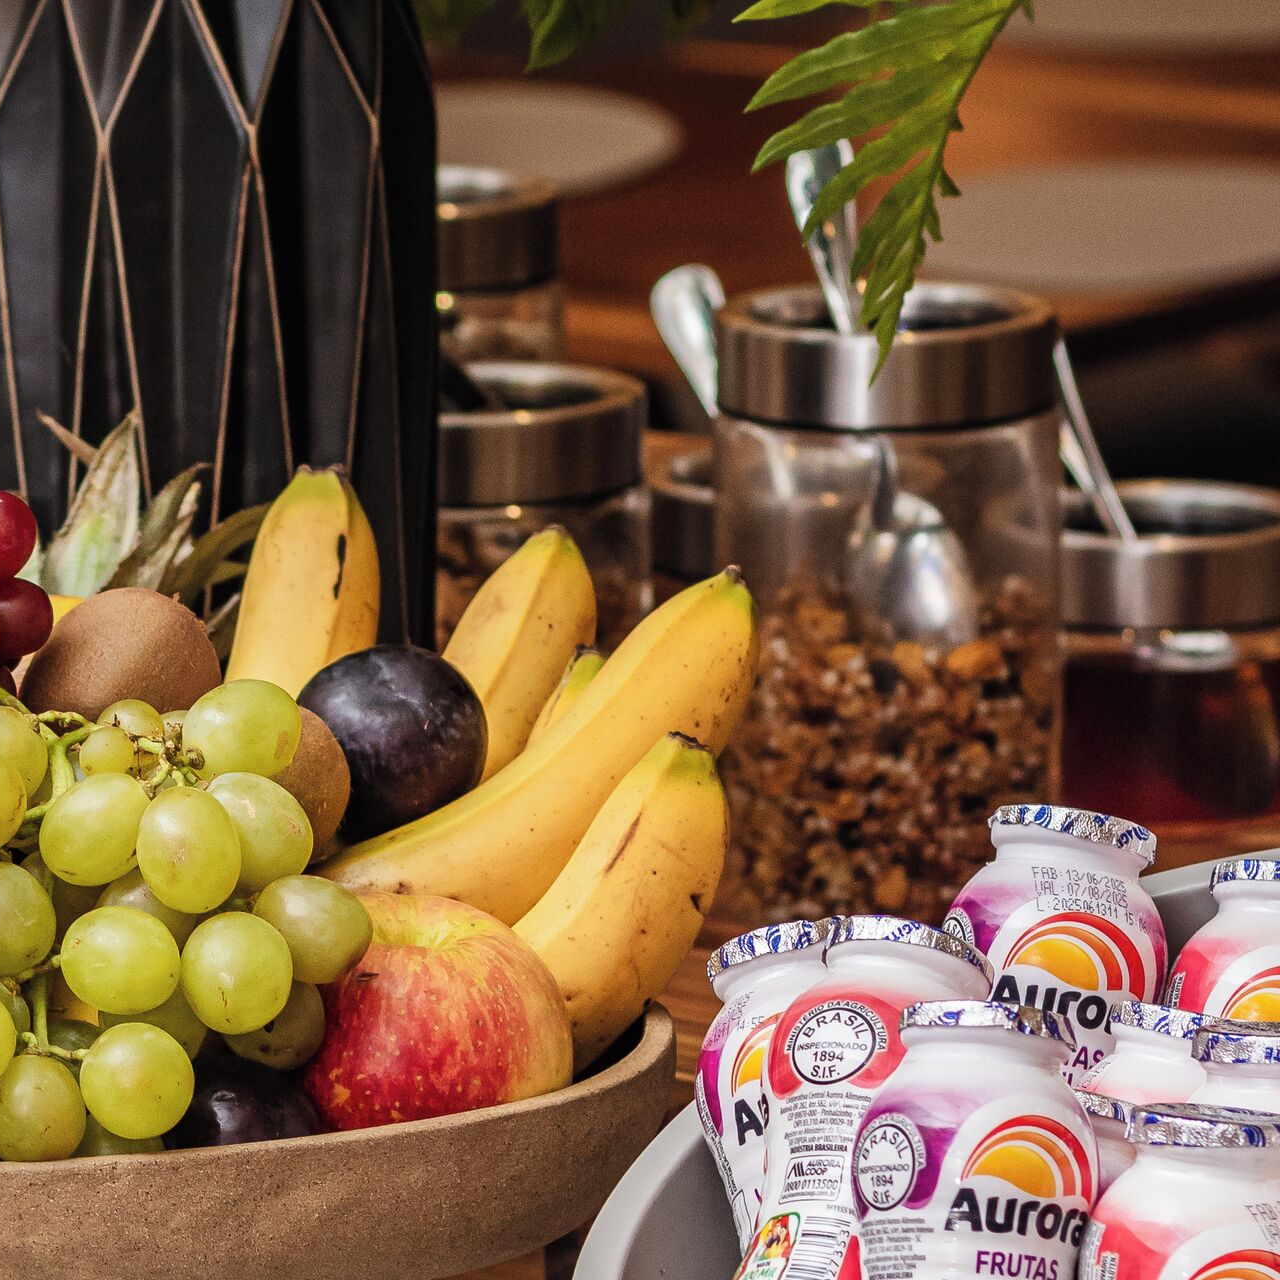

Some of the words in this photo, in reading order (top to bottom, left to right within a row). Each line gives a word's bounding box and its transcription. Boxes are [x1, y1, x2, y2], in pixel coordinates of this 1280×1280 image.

[991, 974, 1113, 1035] Auro
[802, 1012, 869, 1040] BRASIL
[842, 1001, 887, 1051] AGRICULTURA
[796, 1041, 869, 1053] INSPECIONADO
[812, 1050, 845, 1063] 1894
[810, 1065, 841, 1080] S.I.F.
[807, 1160, 841, 1168] AURORA
[805, 1167, 828, 1177] COOP
[944, 1188, 1089, 1247] Aurora
